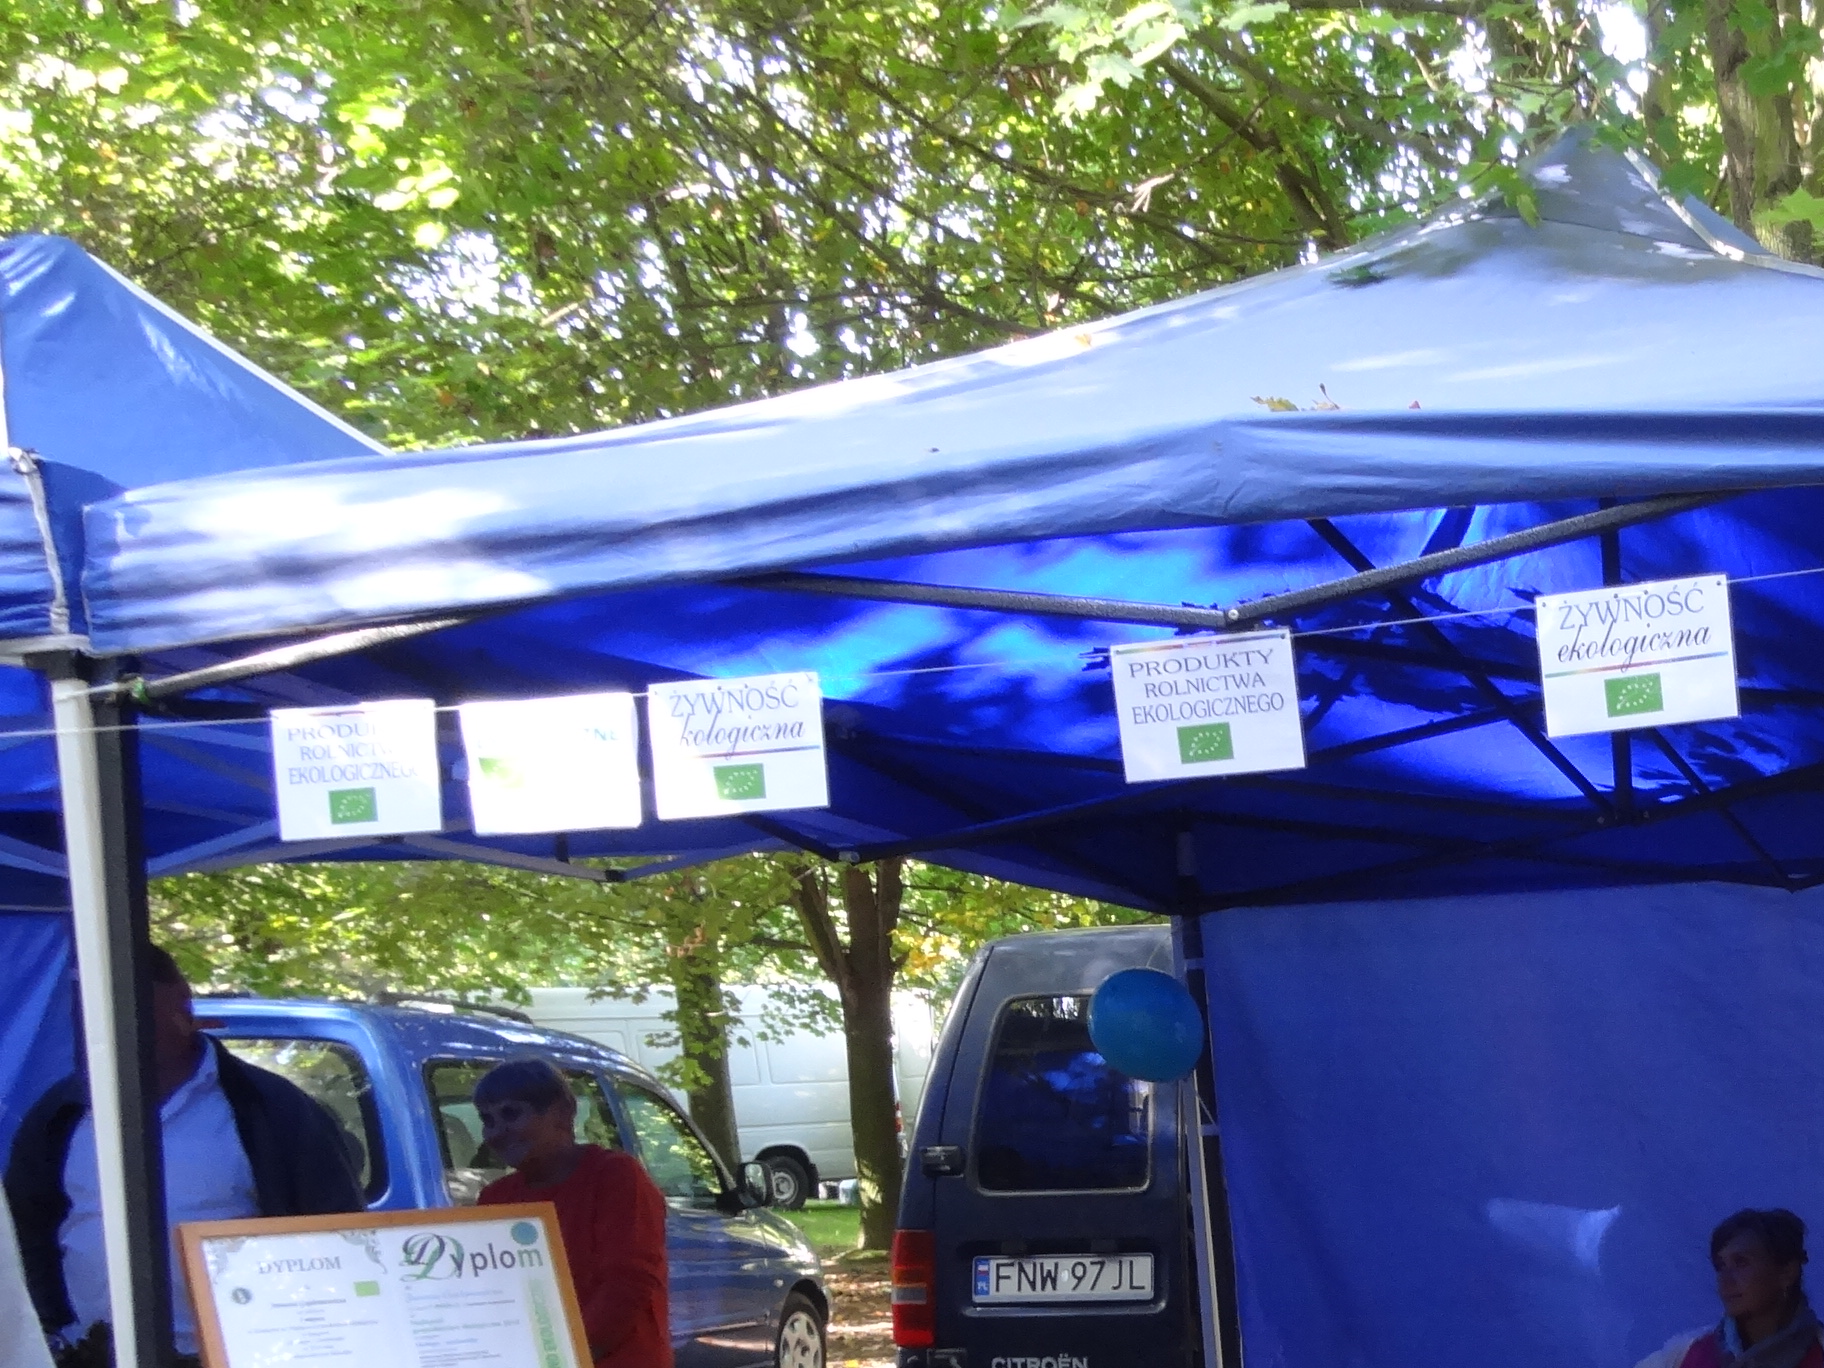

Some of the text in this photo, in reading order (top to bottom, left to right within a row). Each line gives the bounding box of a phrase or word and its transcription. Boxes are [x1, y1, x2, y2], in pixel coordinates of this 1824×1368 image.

[1558, 582, 1704, 630] ŻYWNOŚĆ
[1128, 648, 1273, 678] PRODUKTY
[1558, 620, 1711, 673] ekologiczna
[669, 679, 799, 717] ŻYWNOŚĆ
[1144, 672, 1266, 698] ROLNICTWA
[1132, 692, 1285, 725] EKOLOGICZNEGO
[680, 711, 806, 761] kologiczna
[258, 1256, 342, 1274] DYPLOM
[399, 1232, 544, 1282] Dyplom
[995, 1262, 1058, 1292] FNW
